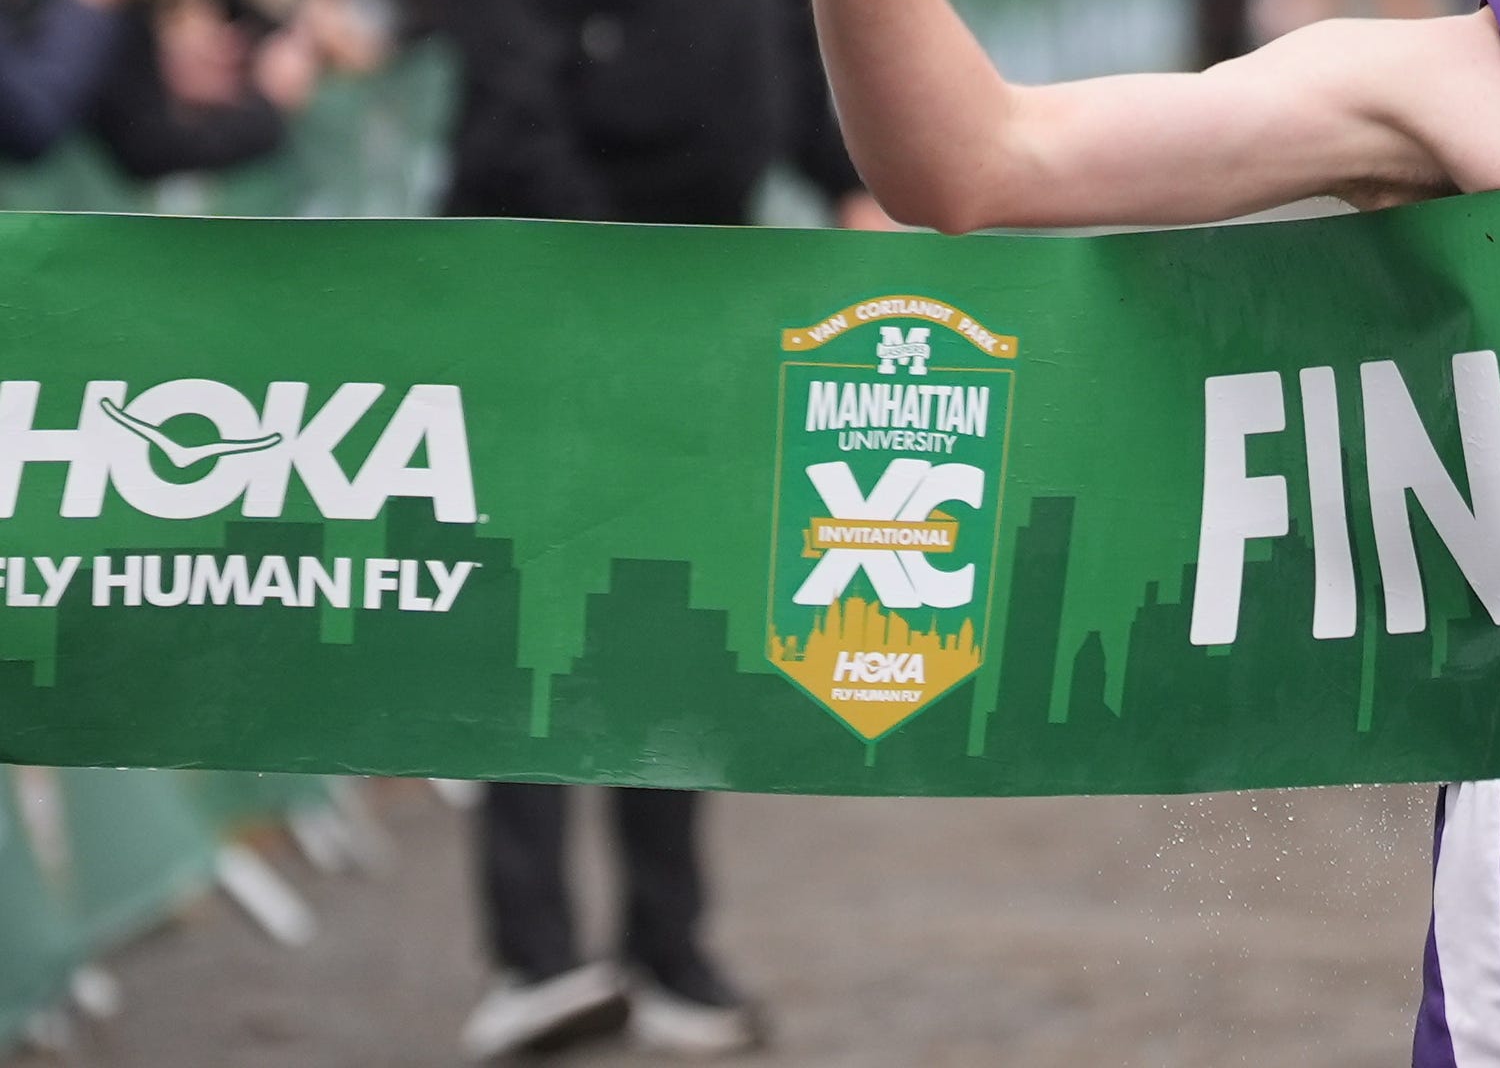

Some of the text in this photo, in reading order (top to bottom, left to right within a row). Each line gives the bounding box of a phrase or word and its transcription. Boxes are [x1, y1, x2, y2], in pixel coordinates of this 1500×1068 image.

[807, 299, 998, 352] VAN CORTLANDT PARK
[805, 381, 989, 437] MANHATTAN
[0, 378, 478, 524] HOKA
[838, 431, 958, 454] UNIVERSITY
[792, 458, 985, 608] XC
[818, 526, 950, 546] INVITATIONAL
[0, 555, 474, 612] LY HUMAN FLY
[833, 651, 925, 684] HOKA
[831, 688, 923, 702] FLY HUMAN FLY
